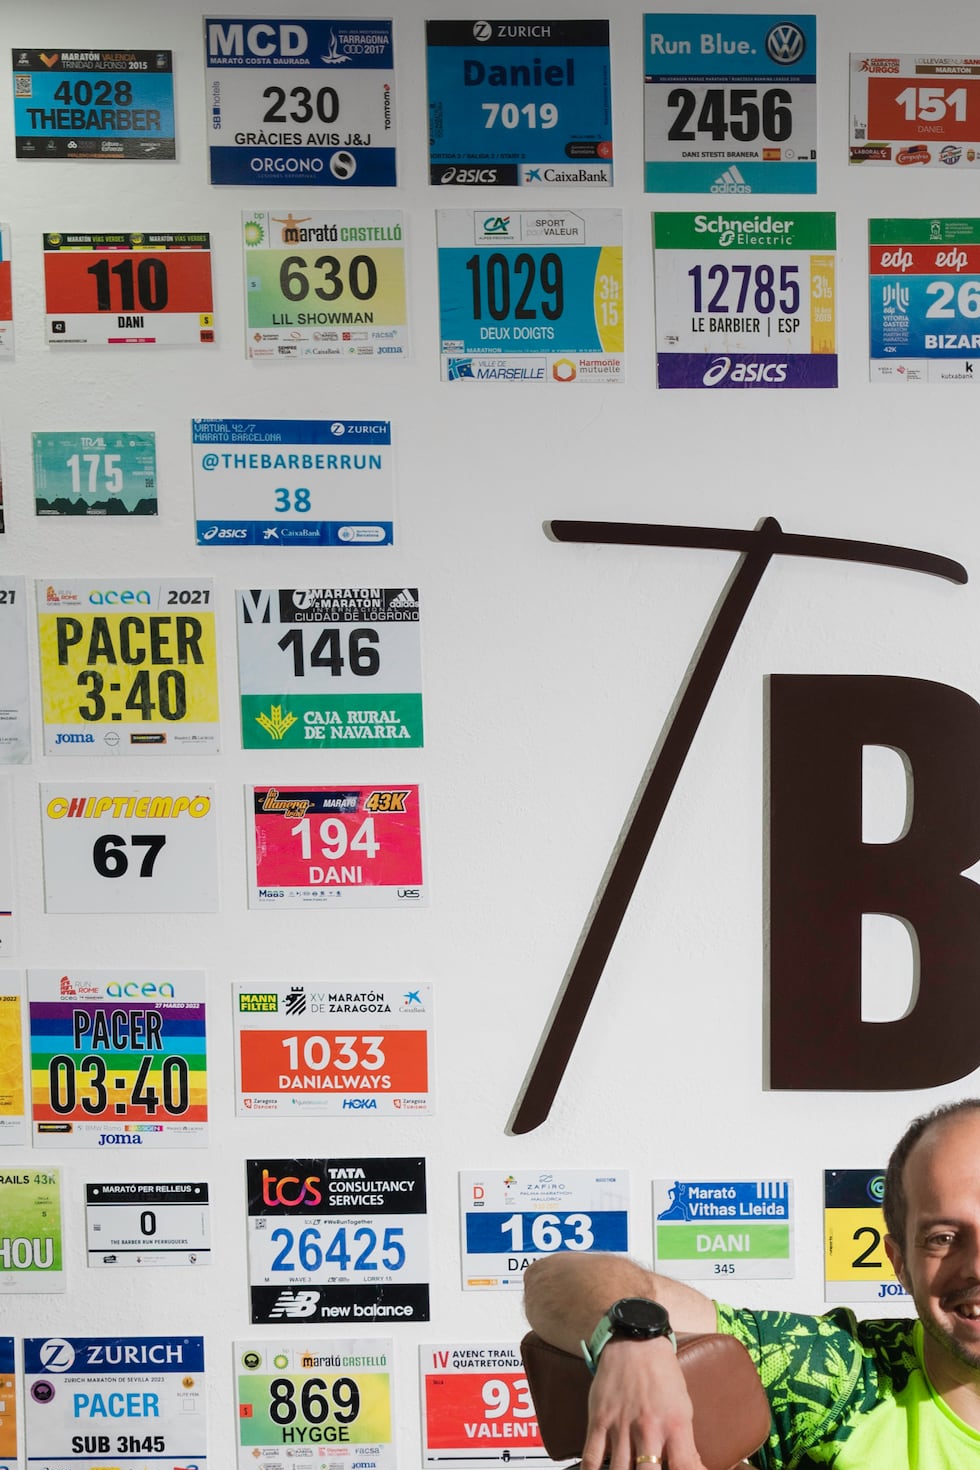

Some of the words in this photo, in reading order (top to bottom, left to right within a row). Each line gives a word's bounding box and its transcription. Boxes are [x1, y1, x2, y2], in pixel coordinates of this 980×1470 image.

[208, 23, 308, 57] MCD
[339, 34, 390, 46] TARRAGONA
[498, 26, 551, 37] ZURICH
[650, 34, 692, 56] Run
[702, 33, 757, 56] Blue.
[465, 59, 576, 87] Daniel
[54, 80, 133, 106] 4028
[263, 86, 340, 124] 230
[668, 88, 793, 142] 2456
[895, 88, 968, 122] 151
[27, 108, 161, 131] THEBARBER
[483, 103, 560, 130] 7019
[234, 129, 302, 146] GRÀCIES
[306, 133, 340, 146] AVIS
[345, 133, 372, 147] J&J
[250, 157, 324, 173] ORGONO
[544, 170, 608, 184] CaixaBank
[285, 224, 338, 244] marató
[340, 223, 402, 241] CASTELLÓ
[694, 214, 795, 234] Schneider
[737, 234, 793, 245] Electric
[88, 257, 169, 311] 110
[280, 254, 377, 302] 630
[466, 252, 564, 321] 1029
[688, 263, 800, 314] 12785
[117, 315, 144, 329] DANI
[273, 312, 295, 325] LIL
[298, 311, 374, 325] SHOWMAN
[692, 318, 706, 333] LE
[710, 318, 760, 333] BARBIER
[778, 317, 800, 333] ESP
[480, 327, 510, 341] DEUX
[513, 327, 555, 341] DOIGTS
[476, 367, 546, 380] MARSEILLE
[731, 362, 788, 382] asics
[347, 425, 387, 435] ZURICH
[202, 453, 382, 472] @THEBARBERRUN
[67, 454, 124, 493] 175
[274, 487, 312, 514] 38
[168, 590, 211, 605] 2021
[57, 616, 205, 667] PACER
[278, 627, 381, 677] 146
[77, 669, 188, 722] 3:40
[303, 711, 342, 725] CAJA
[347, 710, 401, 724] RURAL
[304, 726, 325, 739] DE
[331, 725, 411, 739] NAVARRA
[46, 795, 212, 820] CHIPTIEMPO
[291, 817, 380, 860] 194
[92, 834, 167, 879] 67
[309, 866, 362, 884] DANI
[241, 1001, 277, 1011] FILTER
[327, 990, 385, 1002] MARATÓN
[329, 1003, 391, 1013] ZARAGOZA
[74, 1009, 163, 1051] PACER
[282, 1036, 386, 1072] 1033
[49, 1055, 190, 1117] 03:40
[279, 1074, 392, 1091] DANIALWAYS
[328, 1168, 367, 1179] TATA
[102, 1184, 136, 1194] MARATÓ
[138, 1184, 153, 1194] PER
[156, 1184, 192, 1194] RELLEUS
[262, 1168, 322, 1207] tcs
[328, 1180, 416, 1193] CONSULTANCY
[688, 1183, 737, 1200] Marató
[328, 1194, 384, 1207] SERVICES
[689, 1201, 737, 1217] Vithas
[740, 1201, 786, 1216] Lleida
[501, 1213, 595, 1252] 163
[271, 1227, 406, 1274] 26425
[695, 1234, 751, 1253] DANI
[713, 1263, 736, 1275] 345
[321, 1304, 350, 1318] new
[353, 1302, 414, 1318] balance
[87, 1344, 184, 1365] ZURICH
[433, 1351, 450, 1369] IV
[452, 1349, 485, 1363] AVENC
[488, 1348, 516, 1362] TRAIL
[73, 1392, 160, 1419] PACER
[269, 1377, 361, 1426] 869
[282, 1426, 351, 1444] HYGGE
[71, 1436, 111, 1456] SUB
[117, 1435, 166, 1455] 3h45
